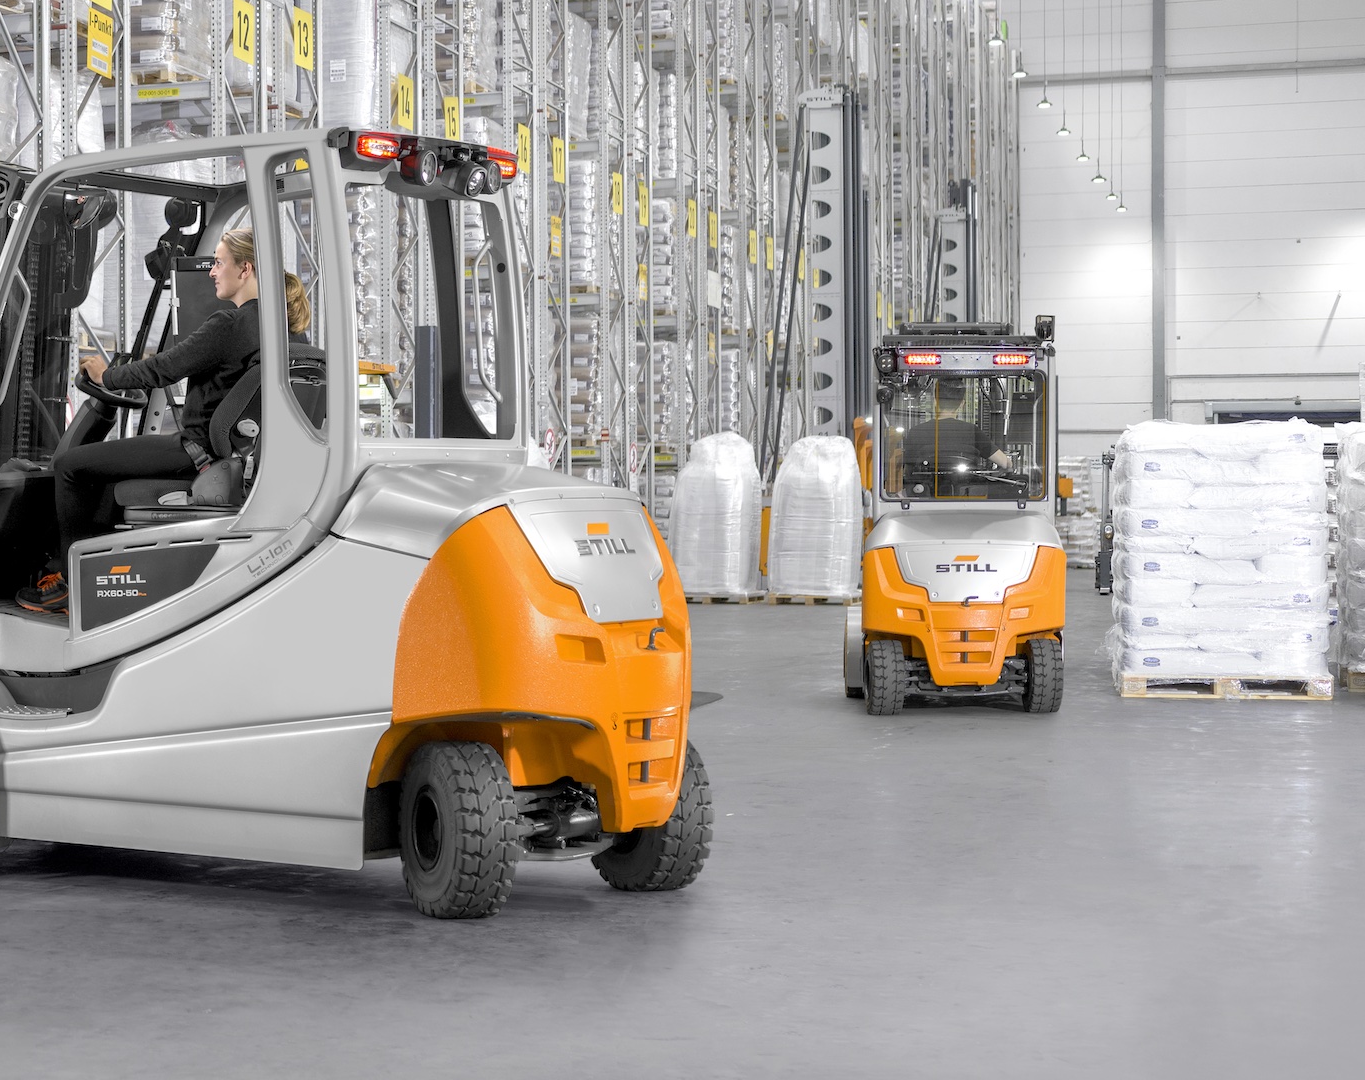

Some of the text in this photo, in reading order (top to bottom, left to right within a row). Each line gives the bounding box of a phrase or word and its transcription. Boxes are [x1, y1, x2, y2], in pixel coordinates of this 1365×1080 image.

[237, 9, 249, 52] 12
[297, 20, 309, 58] 13
[401, 85, 411, 119] 14
[447, 106, 456, 137] 15
[519, 133, 528, 163] 16
[554, 148, 562, 174] 17
[246, 538, 294, 574] Li-Ion
[574, 538, 636, 557] STILL
[252, 547, 297, 579] TECHNOLOGY
[935, 563, 998, 573] STILL
[96, 573, 147, 586] STILL
[97, 589, 139, 598] RX60-50
